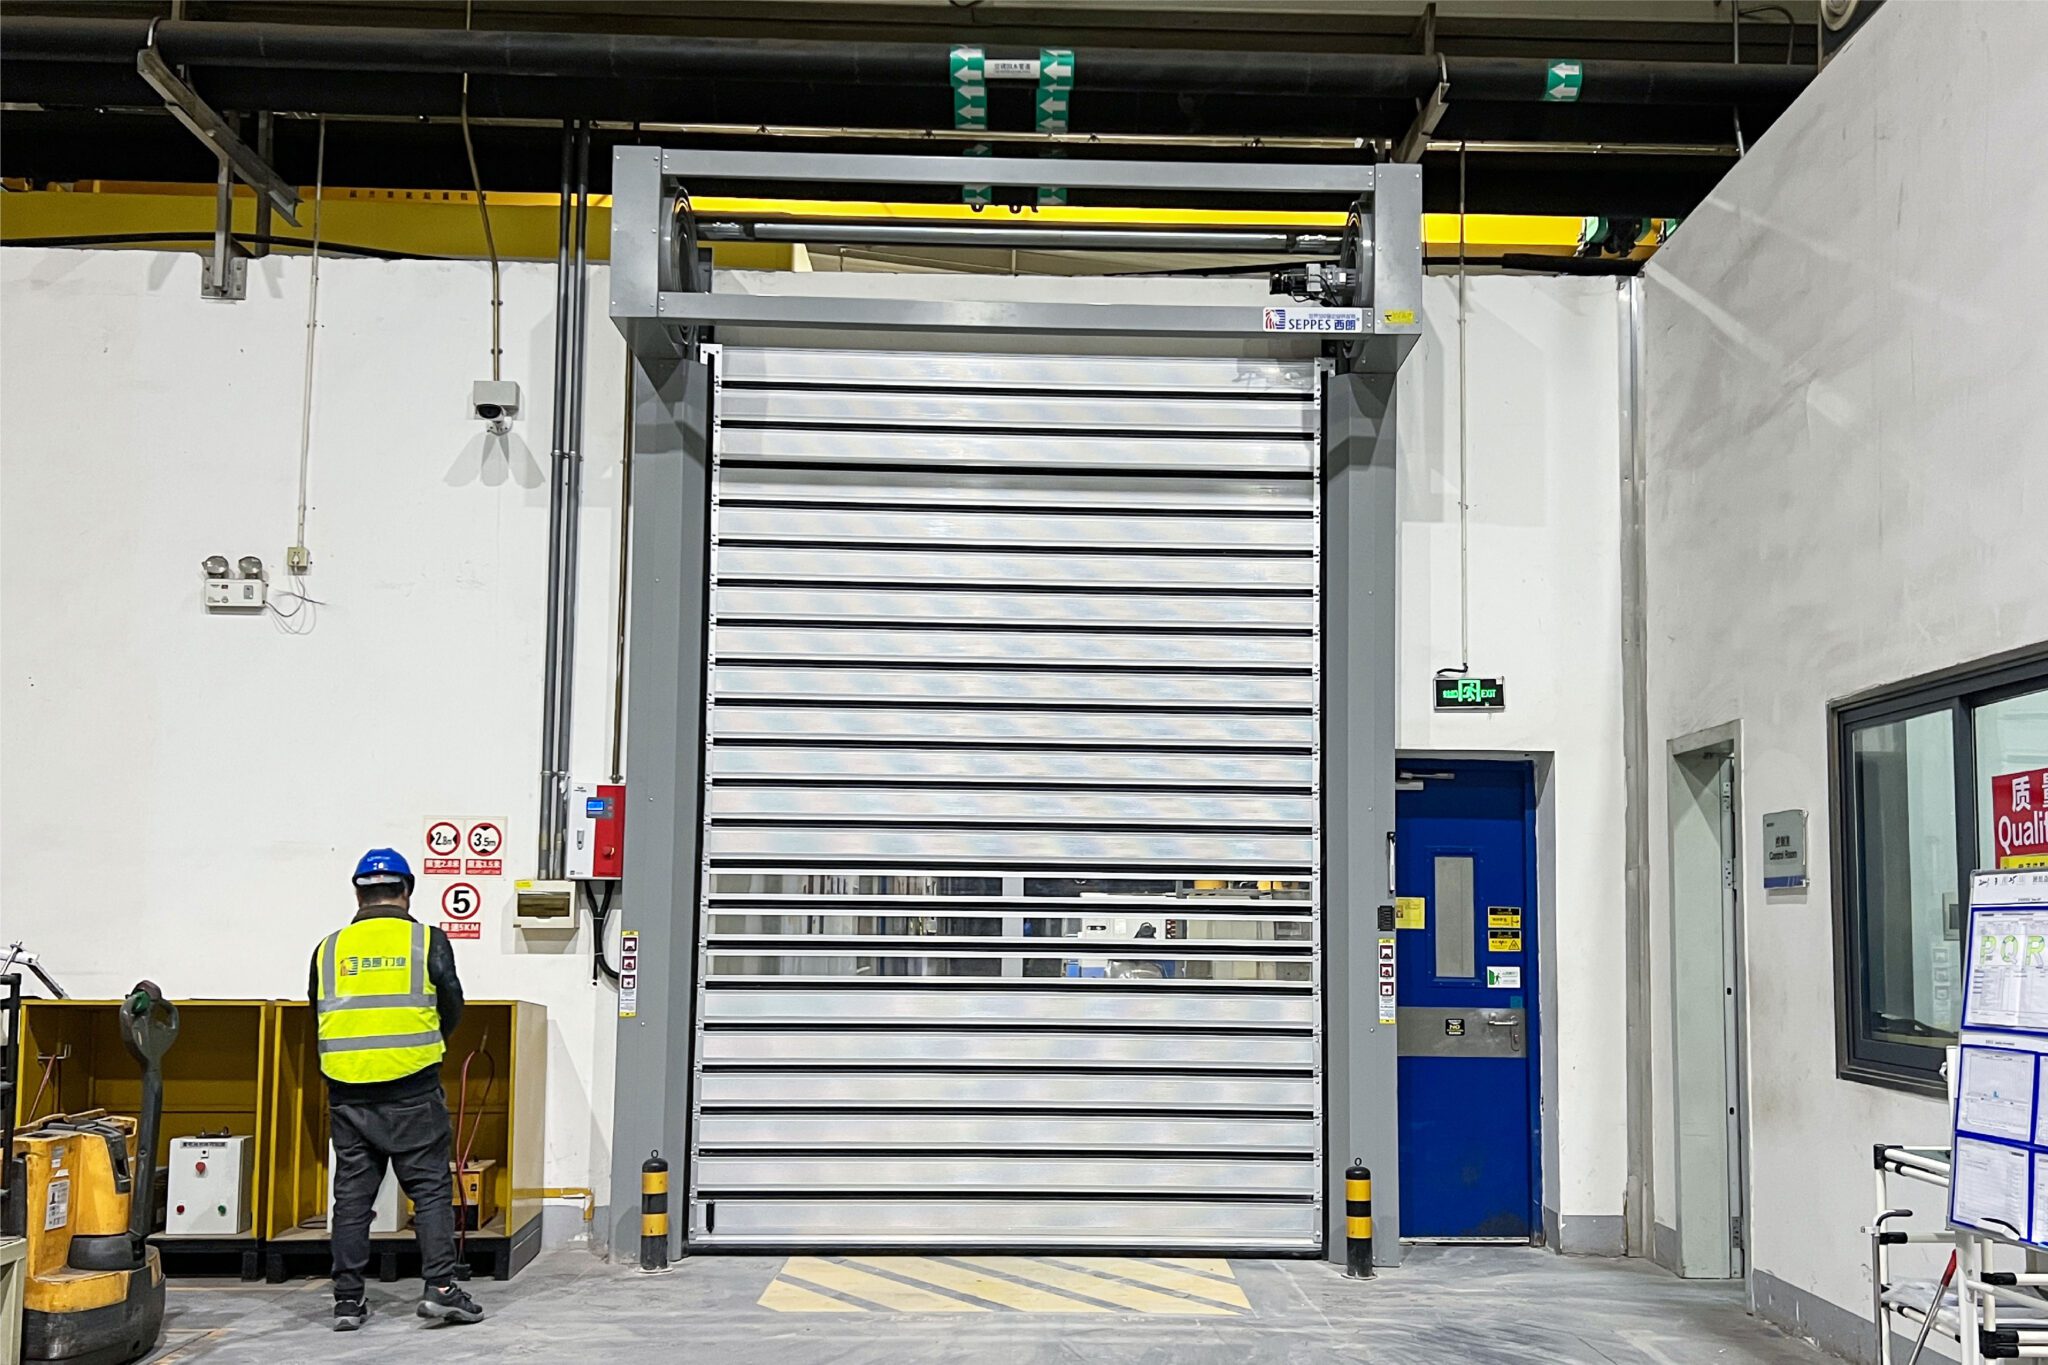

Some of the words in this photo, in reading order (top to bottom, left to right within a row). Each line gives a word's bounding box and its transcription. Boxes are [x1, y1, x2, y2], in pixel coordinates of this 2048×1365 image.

[1289, 318, 1331, 330] SEPPES
[1334, 319, 1356, 331] 西朗
[473, 833, 496, 847] 3.5m
[452, 889, 471, 914] 5
